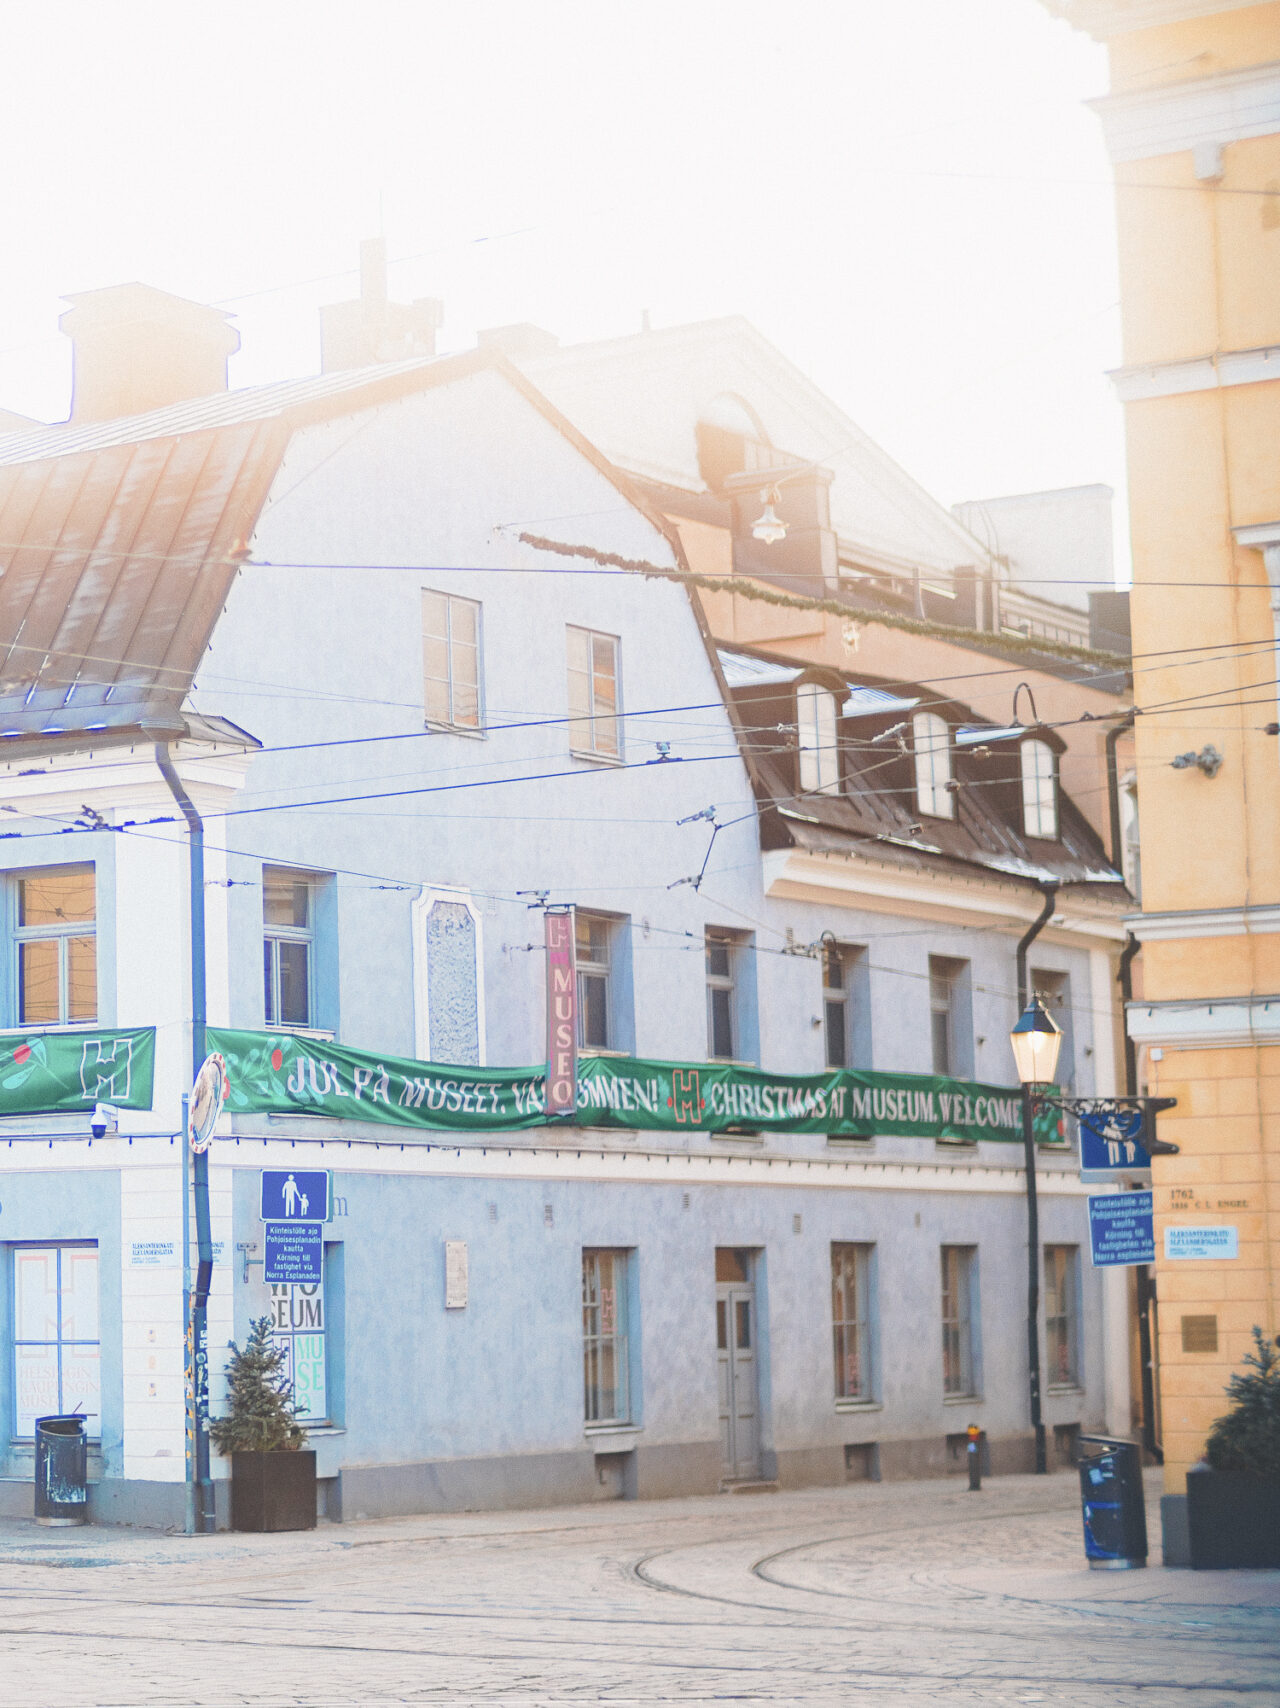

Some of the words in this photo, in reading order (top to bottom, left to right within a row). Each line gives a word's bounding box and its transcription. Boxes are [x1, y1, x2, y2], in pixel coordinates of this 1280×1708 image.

[552, 967, 573, 1105] MUSEO
[287, 1056, 350, 1097] JUL
[353, 1063, 391, 1105] PÅ
[398, 1075, 507, 1114] MUSEET.
[710, 1081, 826, 1120] CHRISTMAS
[829, 1087, 848, 1119] AT
[852, 1086, 938, 1123] MUSEUM.
[269, 1226, 306, 1235] Kiinteistölle
[308, 1227, 318, 1236] ajo
[266, 1235, 321, 1245] Pohjoisesplanadin
[283, 1244, 304, 1252] kautta
[276, 1253, 300, 1262] Körning
[273, 1263, 302, 1271] fastighet
[266, 1271, 284, 1279] Norra
[285, 1271, 321, 1280] Esplanaden
[296, 1336, 323, 1360] MU
[296, 1361, 324, 1391] SE
